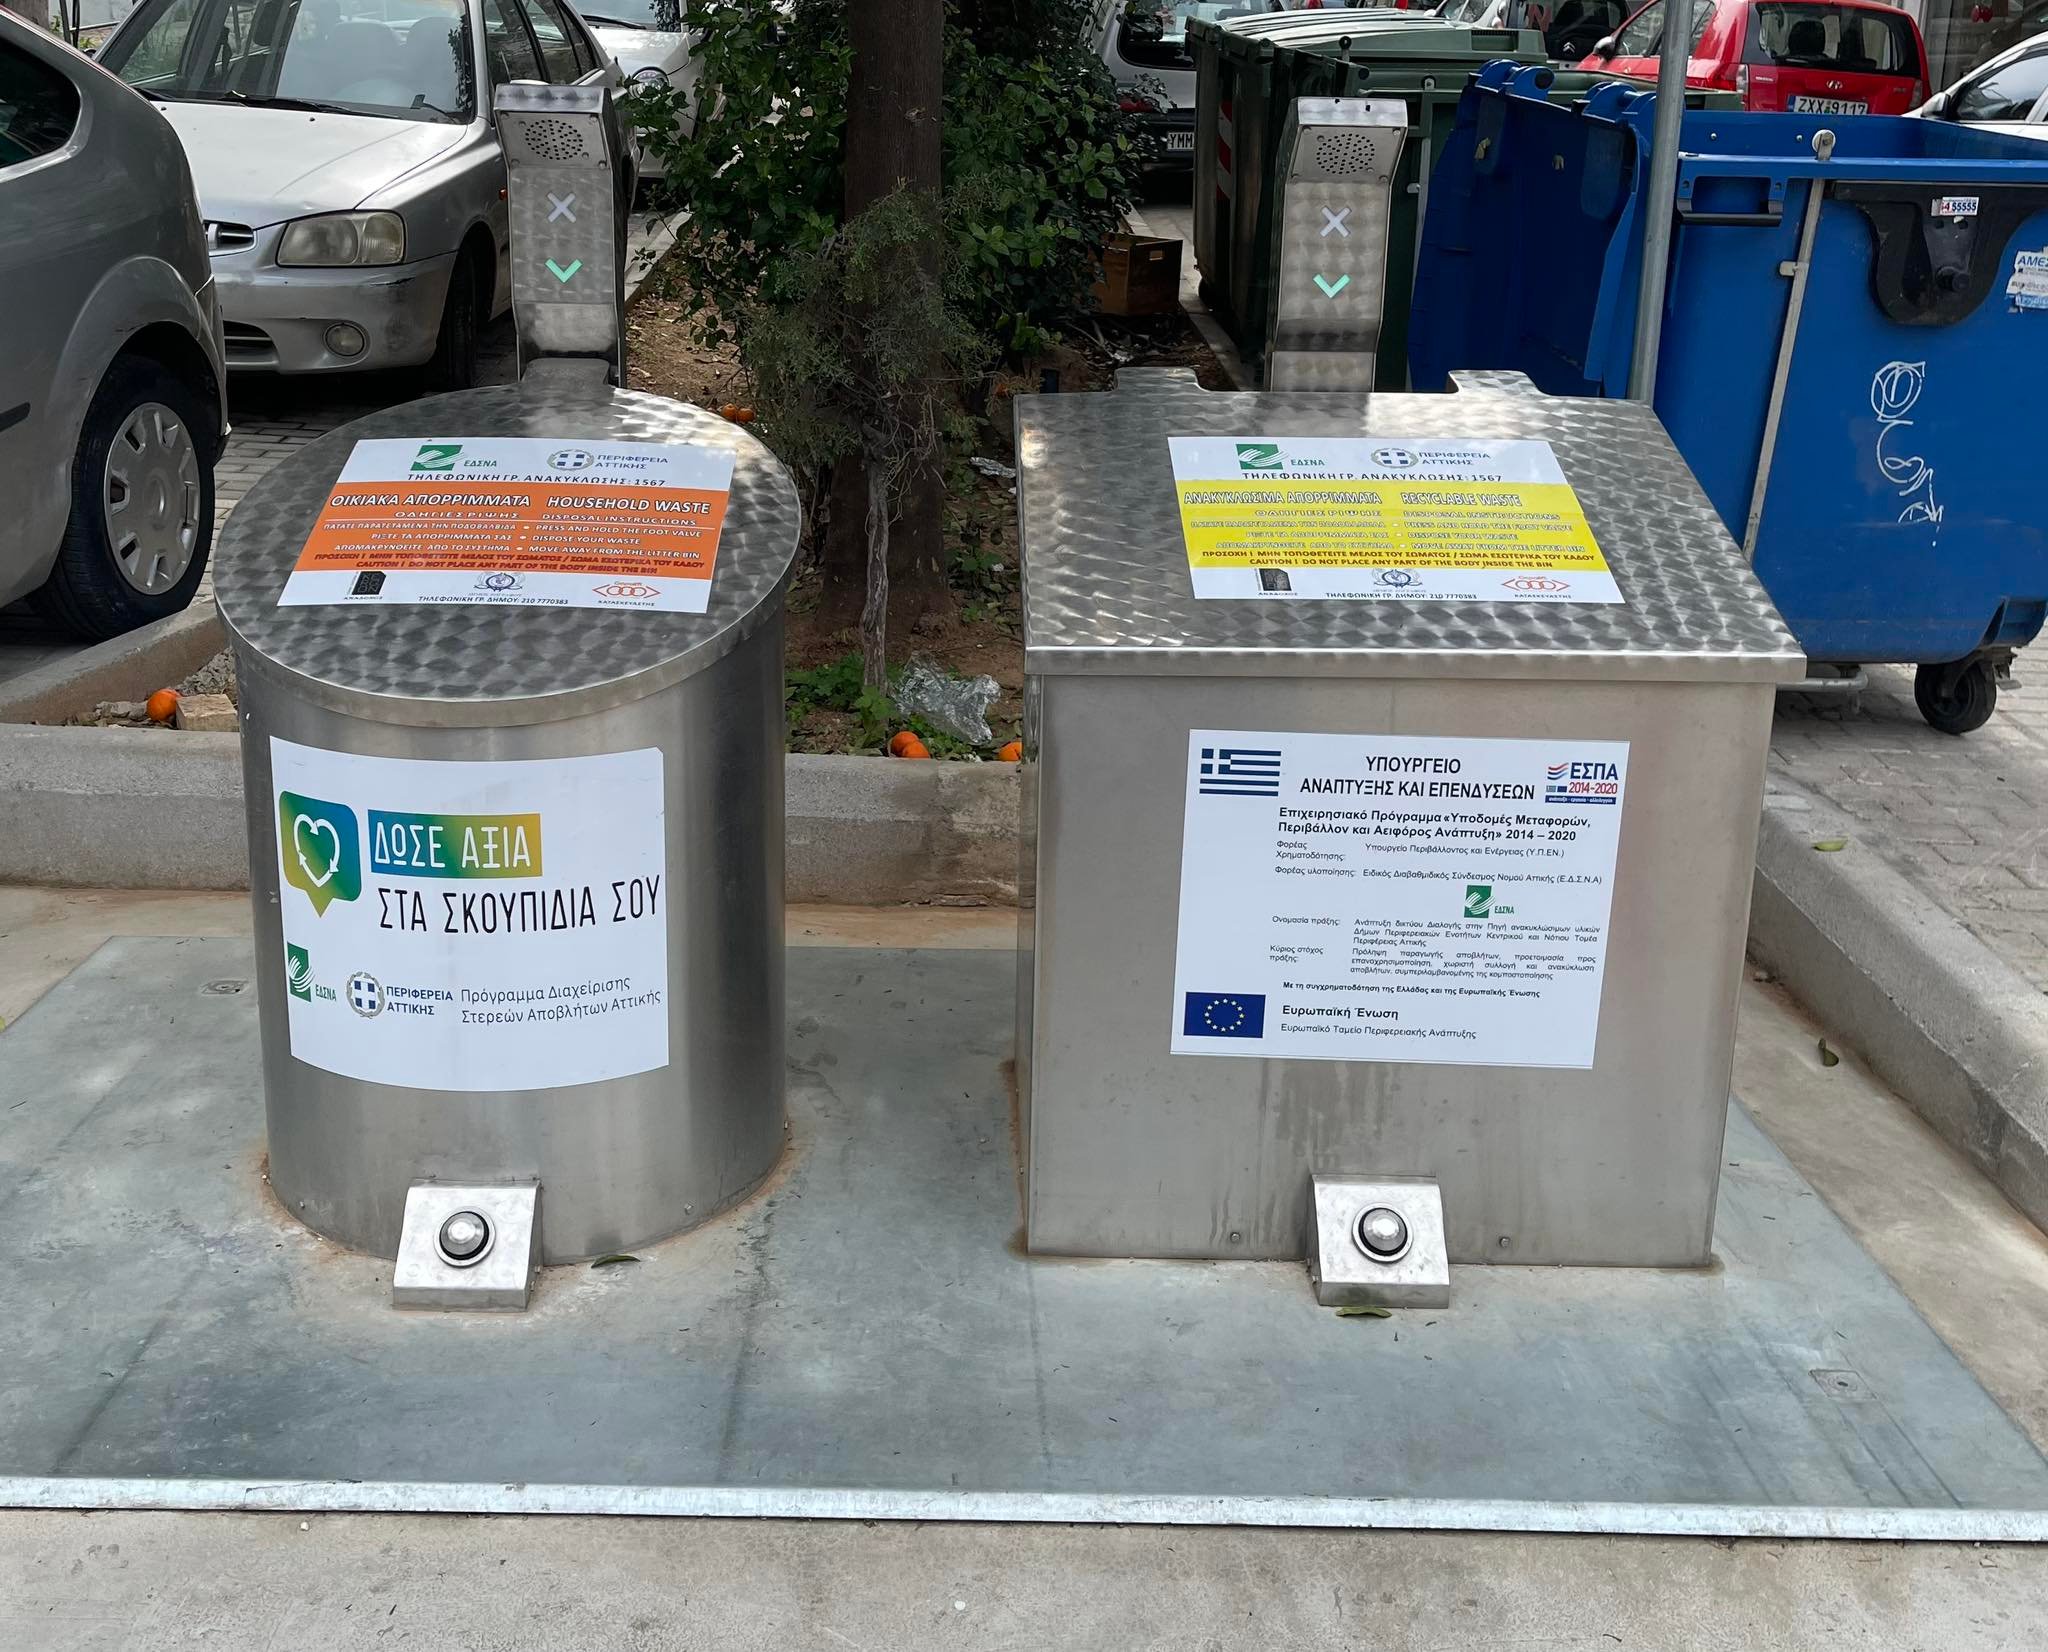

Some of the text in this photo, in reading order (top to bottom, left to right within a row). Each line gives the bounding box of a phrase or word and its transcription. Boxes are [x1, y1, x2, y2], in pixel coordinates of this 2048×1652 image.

[1831, 102, 1866, 115] 9117
[597, 454, 669, 464] ΠΕΡΙΦΕΡΕΙΑ
[1418, 451, 1491, 459] ΠΕΡΙΦΕΡΕΙΑ
[464, 459, 498, 467] ΕΔΣΝΑ
[595, 462, 647, 470] ΑΤΤΙΚΗΣ
[407, 473, 666, 487] ΤΗΛΕΦΩΝΙΚΗ ΓΡ. ΑΝΑΚΥΚΛΩΣΗΣ: 1567
[1242, 472, 1336, 480] ΤΗΛΕΦΩΝΙΚΗ
[1361, 473, 1469, 481] ΑΝΑΚΥΚΛΩΣΗΣ:
[1472, 474, 1502, 482] 1567
[330, 493, 531, 507] ΟΙΚΙΑΚΑ ΑΠΟΡΡΙΜΜΑΤΑ
[1184, 491, 1383, 504] ΑΝΑΚΥΚΛΩΣΙΜΑ ΑΠΟΡΡΙΜΜΑΤΑ
[1400, 492, 1523, 507] RECYCLABLE WASTE
[547, 496, 711, 515] HOUSEHOLD WASTE
[395, 511, 519, 519] ΟΔΗΓΙΕΣ ΡΙΨΗΣ
[542, 513, 696, 526] DISPOSAL INSTRUCTIONS
[415, 533, 492, 541] ΑΠΟΡΡΙΜΜΑΤΑ
[536, 524, 565, 532] PRESS
[672, 529, 702, 538] VALVE
[532, 535, 641, 545] DISPOSE YOUR WASTE
[528, 545, 700, 559] MOVE AWAY FROM THE LITTER BIN
[1366, 756, 1461, 774] ΥΠΟΥΡΓΕΙΟ
[1570, 762, 1619, 780] ΕΣΠΑ
[1300, 778, 1535, 800] ΑΝΑΠΤΥΞΗΣ ΚΑΙ ΕΠΕΝΔΥΣΕΩΝ
[1568, 782, 1618, 794] 2014-2020
[1279, 807, 1591, 828] Επιχειρησιακό Πρόγραμμα «Υποδομές Μεταφορών,
[1278, 822, 1576, 841] Περιβάλλον και Αειφόρος Ανάπτυξη» 2014 2020
[374, 821, 531, 869] ΔΩΣΕ ΑΞΙΑ
[1276, 840, 1307, 850] Φορέας
[1366, 843, 1407, 853] Υπουργείο
[1410, 844, 1468, 855] Περιβάλλοντος
[1485, 848, 1524, 857] Ενέργειας
[1526, 848, 1565, 858] (Υ.Π.ΕΝ.)
[1274, 866, 1305, 876] Φορέας
[1363, 869, 1391, 879] Ειδικός
[1393, 870, 1449, 880] Διαβαθμιδικός
[1451, 872, 1495, 882] Σύνδεσμος
[1497, 873, 1524, 883] Νομού
[1525, 874, 1554, 883] Αττικής
[378, 874, 661, 934] ΣΤΑ ΣΚΟΥΠΙΔΙΑ ΣΟΥ
[1494, 905, 1515, 914] ΕΔΣΝΑ
[1272, 915, 1309, 924] Ονομασία
[1354, 919, 1600, 933] Ανάπτυξη δικτύου Διαλογής στην Πηγή ανακυκλώσιμων υλικών
[1353, 937, 1426, 947] Περιφέρειας Αττικής
[1354, 928, 1380, 936] Δήμων
[1385, 929, 1441, 938] Περιφερειακών
[1445, 930, 1482, 939] Ενοτήτων
[1486, 932, 1523, 941] Κεντρικού
[1544, 933, 1569, 942] Νότιου
[1575, 934, 1597, 943] Τομέα
[1270, 945, 1324, 955] Κύριος στόχος
[1352, 948, 1387, 957] Πρόληψη
[1400, 950, 1443, 959] παραγωγής
[1514, 953, 1564, 962] προετοιμασία
[1577, 955, 1596, 963] προς
[1443, 960, 1474, 969] χωριστή
[1484, 961, 1516, 970] συλλογή
[1548, 963, 1594, 972] ανακύκλωση
[1476, 971, 1487, 979] της
[315, 984, 337, 1001] ΕΔΣΝΑ
[386, 986, 453, 1001] ΠΕΡΙΦΕΡΕΙΑ
[461, 976, 631, 1004] Πρόγραμμα Διαχείρισης
[1283, 981, 1294, 989] Με
[1306, 983, 1380, 993] συγχρηματοδότηση
[1382, 985, 1395, 993] της
[1458, 988, 1506, 997] Ευρωπαϊκής
[1509, 989, 1541, 998] Ένωσης
[387, 1002, 434, 1015] ΑΤΤΙΚΗΣ
[461, 990, 661, 1026] Στερεών Αποβλήτων Αττικής
[1282, 1005, 1399, 1021] Ευρωπαϊκή Ένωση
[1281, 1023, 1477, 1040] Ευρωπαϊκό Ταμείο Περιφερειακής Ανάπτυξης
